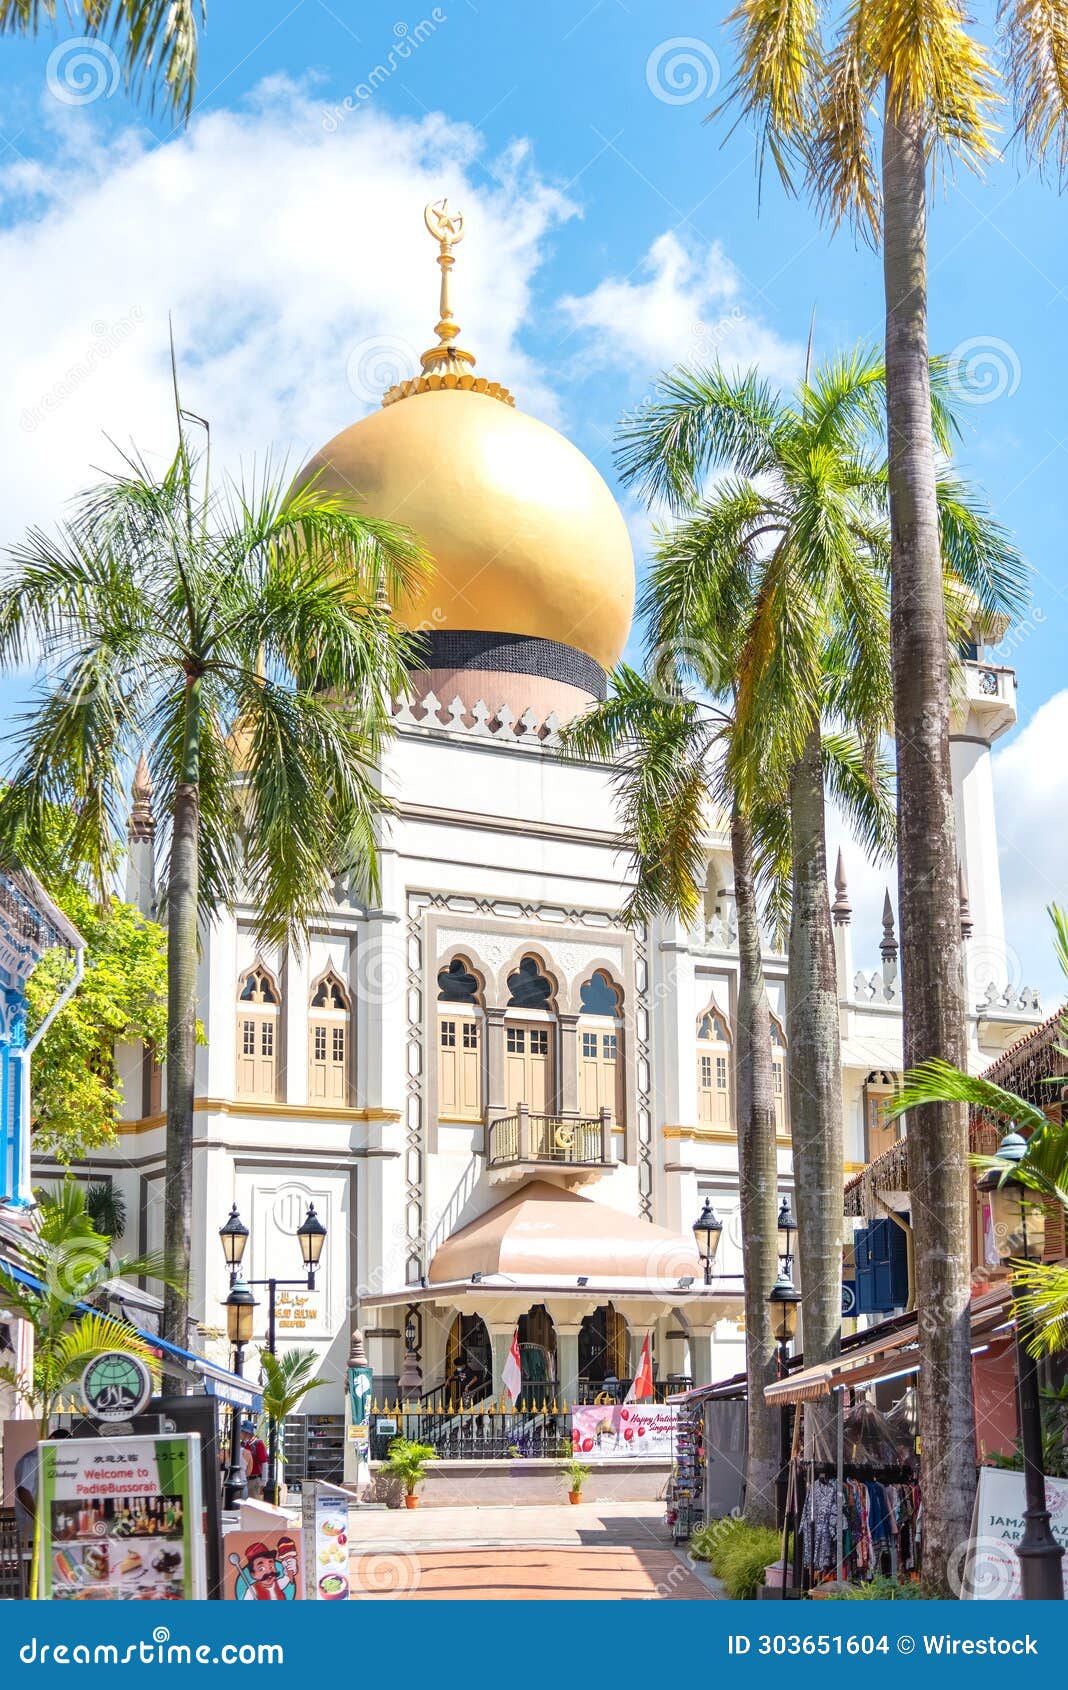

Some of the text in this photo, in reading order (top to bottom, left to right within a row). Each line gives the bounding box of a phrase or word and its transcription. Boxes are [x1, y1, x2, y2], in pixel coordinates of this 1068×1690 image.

[653, 1413, 681, 1423] Nation
[84, 1467, 149, 1480] Welcome to
[76, 1481, 158, 1495] Padi@Bussorah
[989, 1515, 1025, 1528] JAMA
